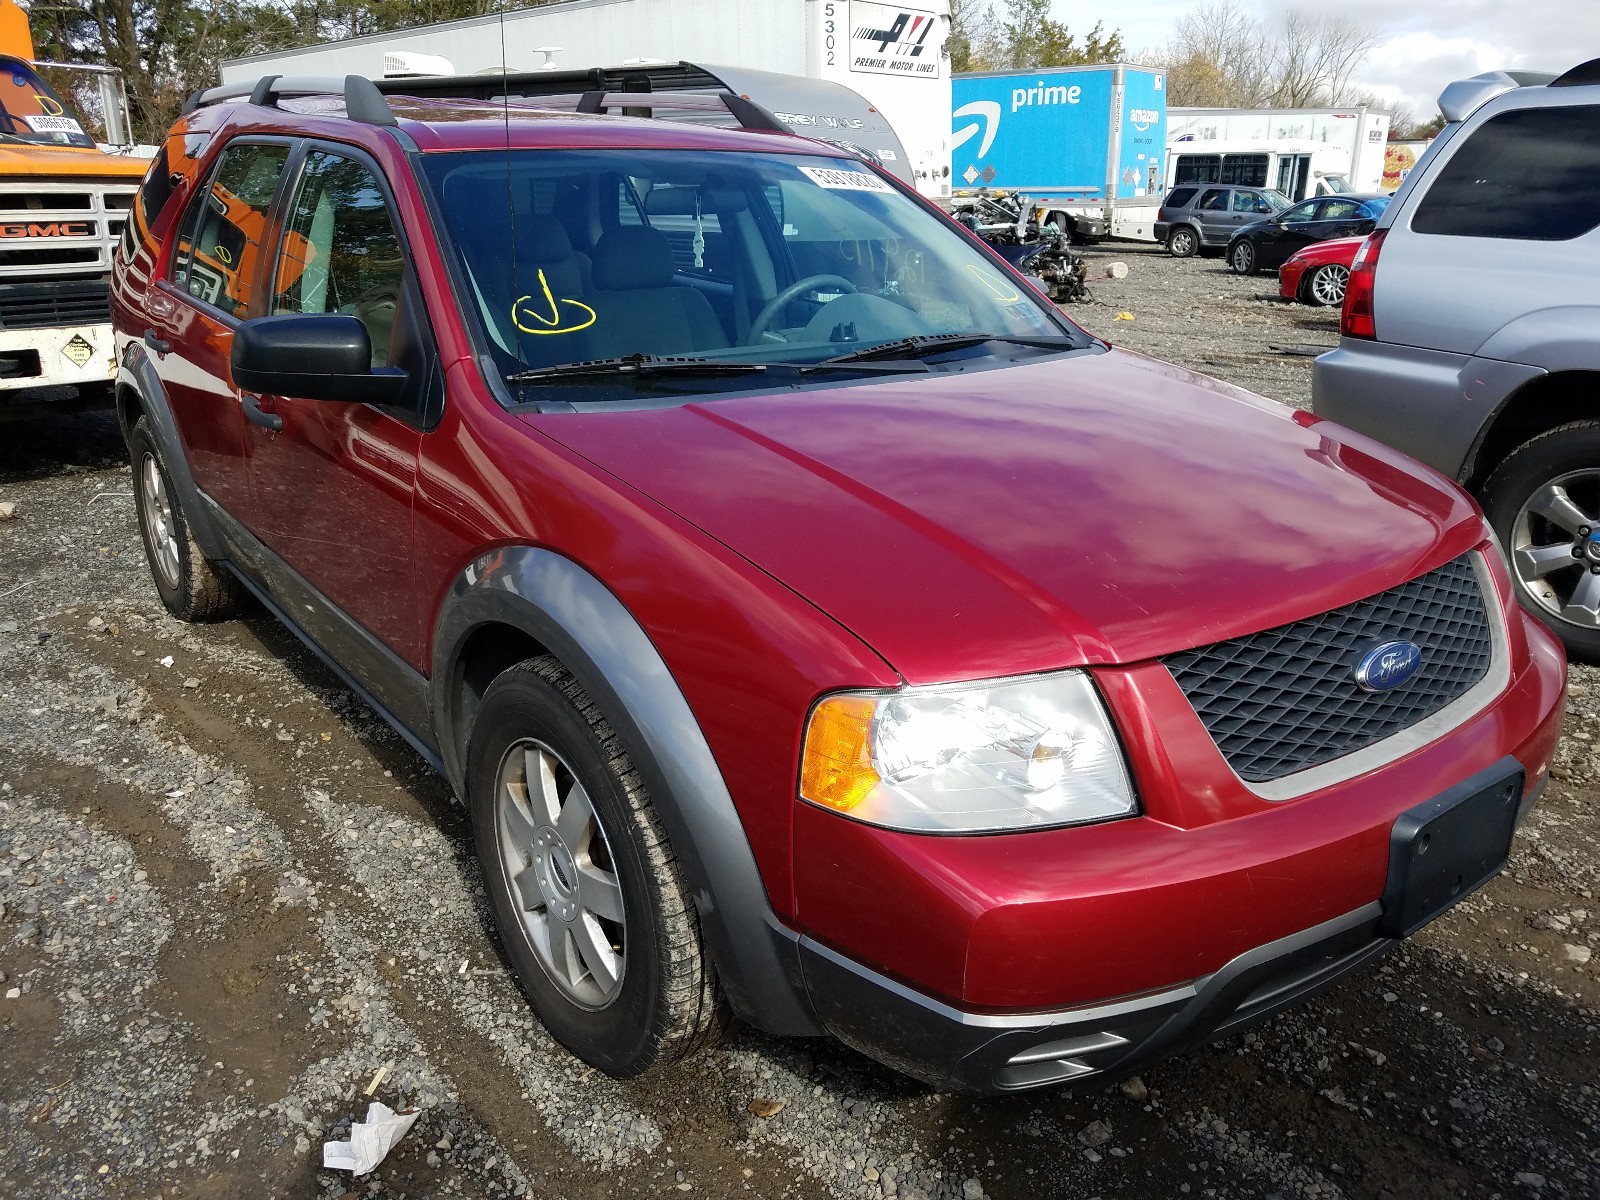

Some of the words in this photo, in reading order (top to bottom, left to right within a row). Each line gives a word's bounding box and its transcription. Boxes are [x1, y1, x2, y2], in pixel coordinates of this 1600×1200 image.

[854, 57, 887, 69] PREMIER
[889, 60, 914, 72] MOTOR
[916, 63, 935, 73] LINES
[1012, 80, 1081, 113] prime
[774, 112, 818, 126] GREY
[1130, 108, 1159, 124] amazon
[0, 222, 89, 238] GMC
[1371, 650, 1413, 682] Ford
